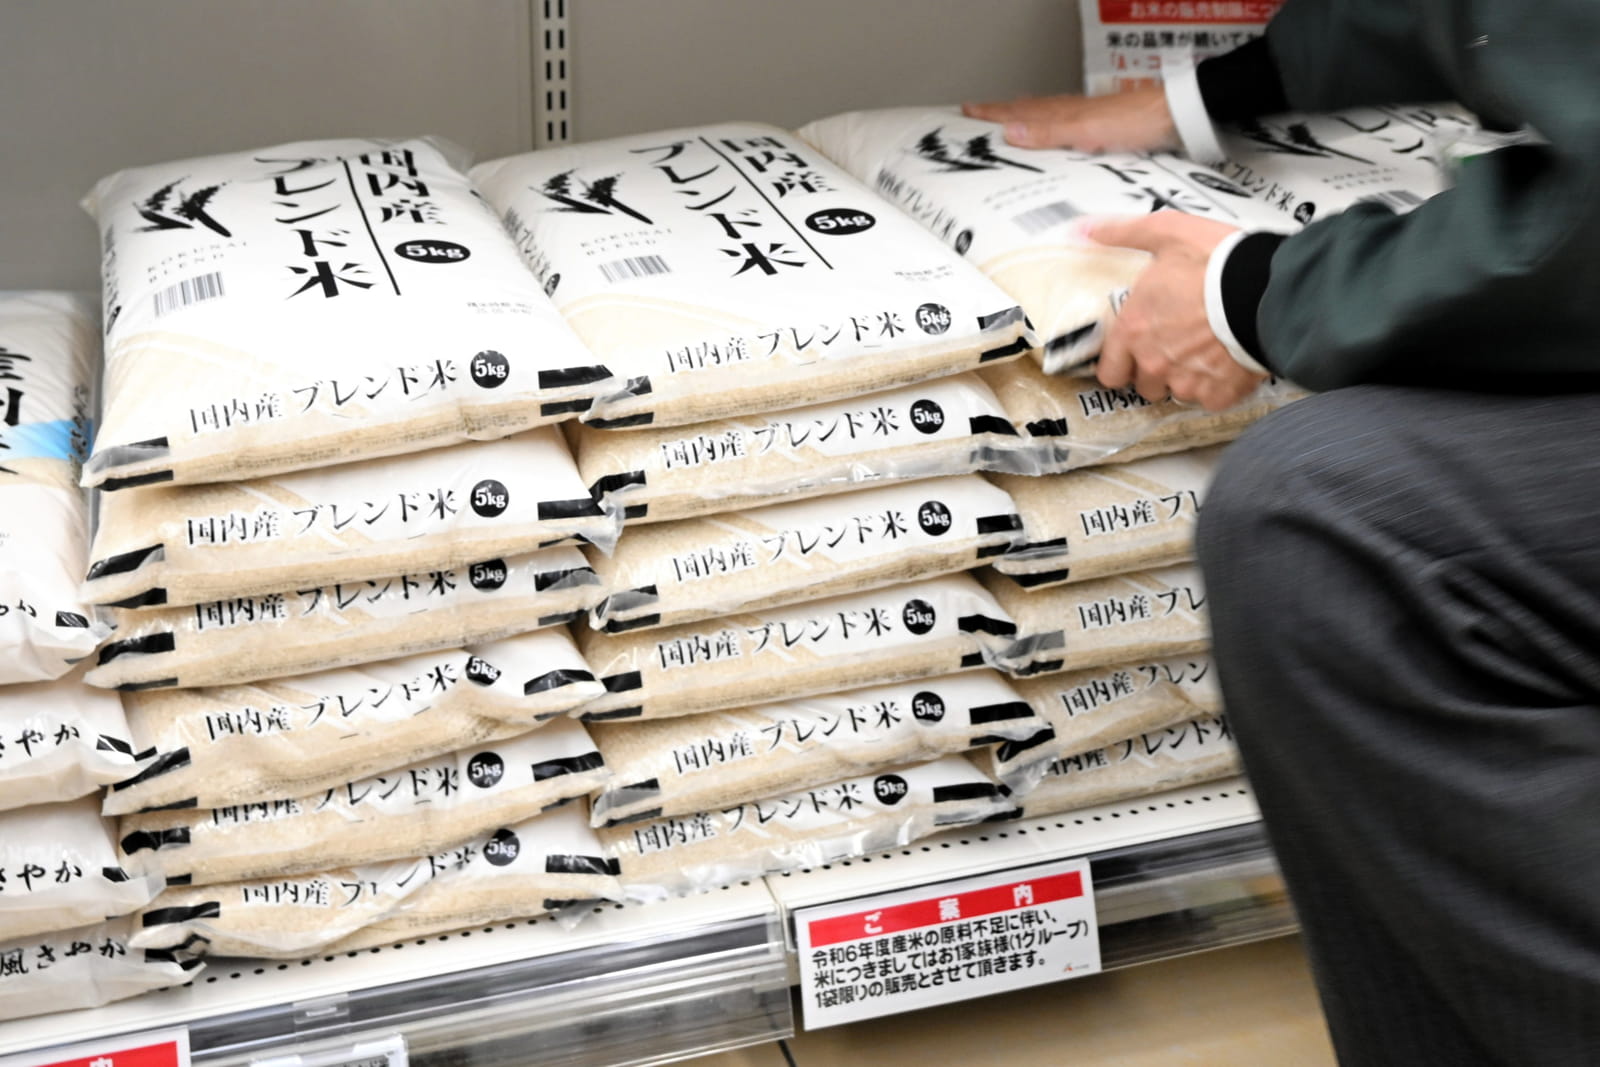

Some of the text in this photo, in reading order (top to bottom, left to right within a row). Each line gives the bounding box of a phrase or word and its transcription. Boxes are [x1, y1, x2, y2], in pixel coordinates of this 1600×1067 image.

[719, 136, 838, 199] 国内産
[253, 157, 378, 300] ブレンド米
[628, 140, 807, 278] ブレンド米
[813, 214, 871, 231] 5kg
[405, 244, 465, 260] 5kg
[665, 310, 950, 374] 国内産 ブレンド米 5kg
[189, 359, 508, 434] 国内産 ブレンド米 5kg
[661, 407, 943, 470] 国内産 ブレンド米 5kg
[186, 487, 507, 546] 国内産 ブレンド米 5kg
[672, 509, 951, 582] 国内産 ブレンド米 5kg
[1079, 500, 1156, 537] 国内産
[195, 592, 287, 630] 国内産
[472, 565, 506, 585] 5kg
[1078, 593, 1152, 630] 国内産
[657, 607, 935, 670] 国内産 ブレンド米 5kg
[205, 706, 292, 741] 国内産
[299, 663, 457, 727] ブレンド米
[468, 657, 500, 680] 5kg
[1061, 671, 1135, 717] 国内産
[672, 699, 945, 775] 国内産 ブレンド米 5kg
[470, 760, 502, 779] 5kg
[633, 811, 717, 855] 国内産
[876, 780, 907, 798] 5kg
[242, 879, 329, 907] 国内産
[486, 838, 518, 858] 5kg
